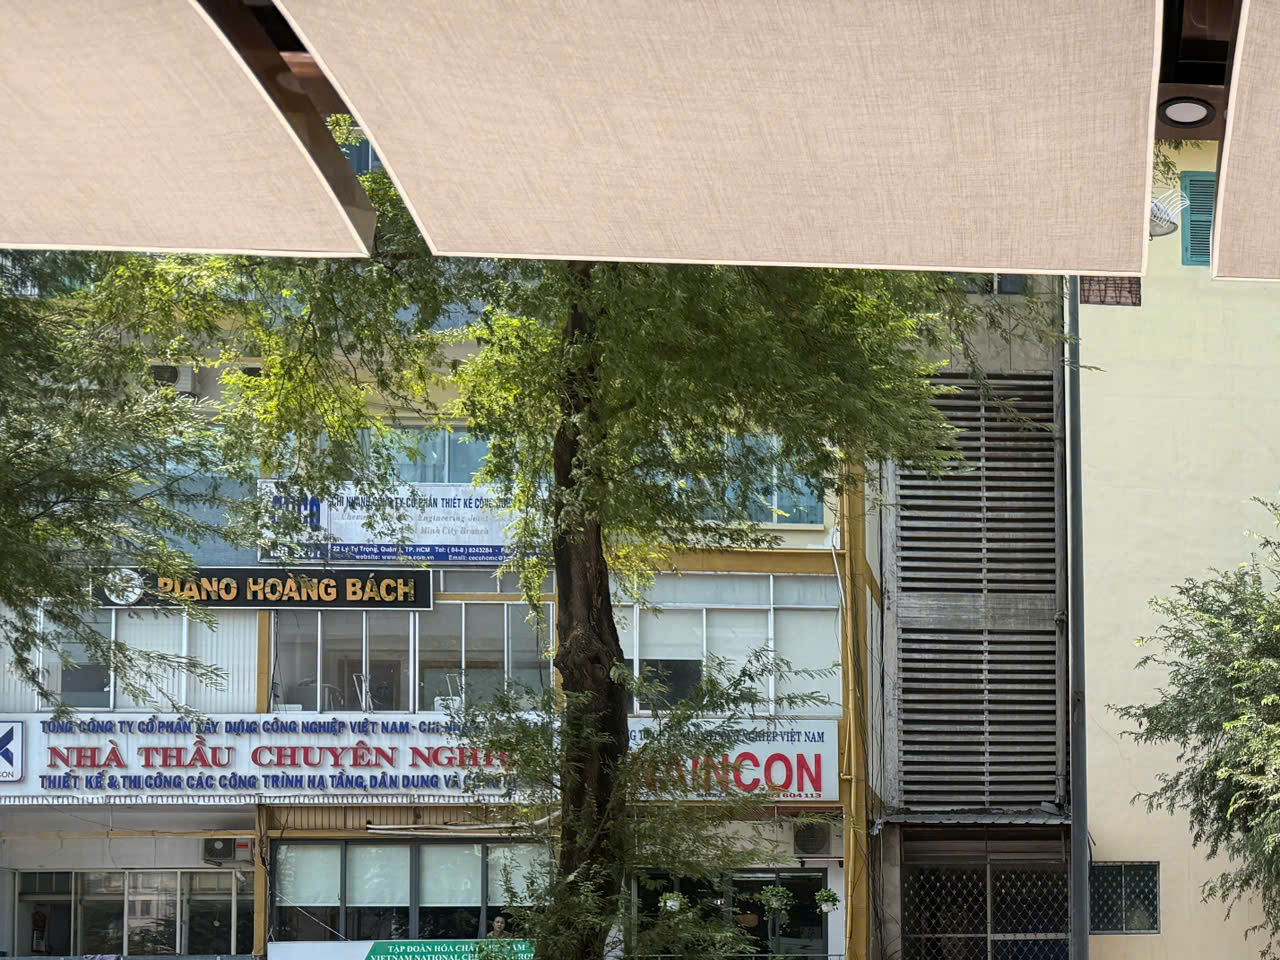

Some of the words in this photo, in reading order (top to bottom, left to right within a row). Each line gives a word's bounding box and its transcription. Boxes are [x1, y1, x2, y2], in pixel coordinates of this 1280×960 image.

[158, 577, 239, 601] PIANO
[246, 572, 338, 602] HOÀNG
[345, 572, 416, 602] BÁCH
[118, 720, 135, 734] TY
[137, 714, 158, 734] CỔ
[225, 719, 258, 736] DỰNG
[262, 717, 298, 734] CÔNG
[301, 717, 347, 737] NGHIỆP
[350, 717, 379, 737] VIỆT
[381, 721, 410, 735] NAM
[780, 727, 803, 745] VIỆT
[803, 730, 825, 743] NAM
[47, 739, 127, 769] NHÀ
[136, 734, 233, 769] THẦU
[251, 740, 398, 769] CHUYÊN
[39, 769, 80, 790] THIẾT
[85, 769, 106, 790] KẾ
[107, 775, 120, 789] &
[120, 775, 144, 789] THI
[144, 771, 184, 789] CÔNG
[186, 771, 214, 789] CÁC
[218, 771, 258, 789] CÔNG
[262, 771, 305, 789] TRÌNH
[307, 774, 328, 791] HẠ
[369, 771, 400, 790] DÂN
[387, 944, 406, 953] TẬP
[407, 943, 433, 953] ĐOÀN
[434, 943, 454, 953] HÓA
